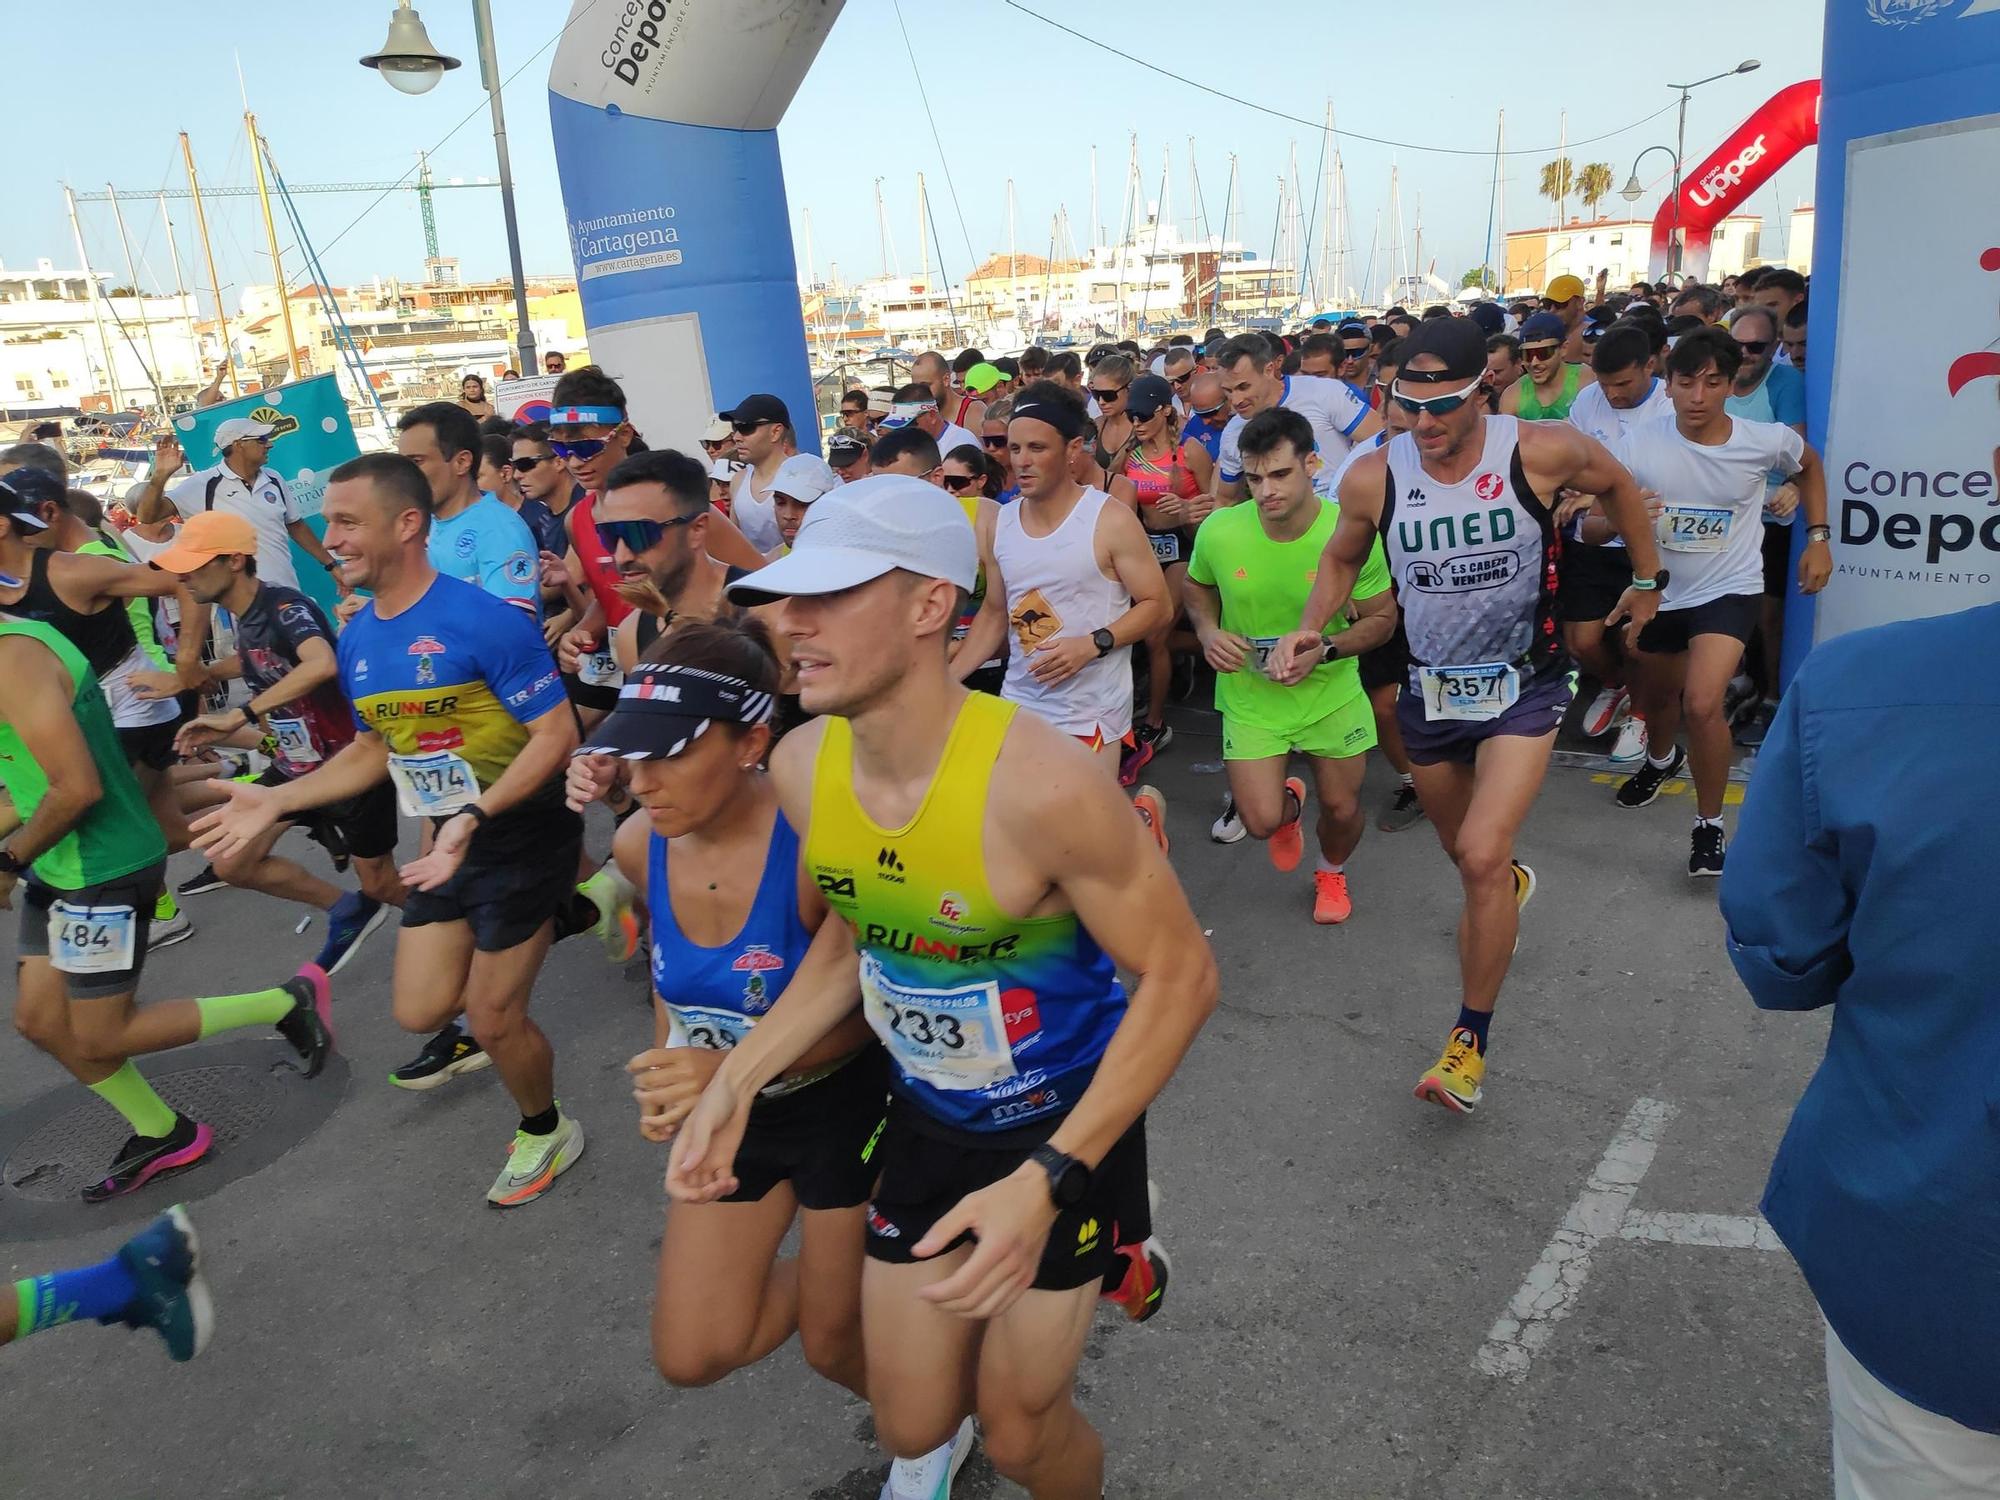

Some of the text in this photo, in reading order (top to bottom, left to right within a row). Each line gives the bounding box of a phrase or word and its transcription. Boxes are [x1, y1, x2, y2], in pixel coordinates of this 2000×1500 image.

[614, 0, 672, 87] Depo
[1699, 165, 1721, 187] grupo
[578, 205, 675, 237] Ayuntamiento
[580, 227, 679, 258] Cartagena
[594, 252, 679, 273] www.cartagena.es
[1399, 507, 1516, 553] UNED
[1670, 515, 1724, 536] 1264
[1469, 556, 1509, 573] CABEZO
[1838, 564, 1991, 584] AYUNTAMIENTO
[1451, 567, 1510, 586] VENTURA
[1447, 675, 1498, 697] 357
[376, 695, 459, 718] RUNNER
[404, 765, 465, 793] 1374
[60, 922, 111, 948] 484
[866, 922, 1021, 962] RUNNER
